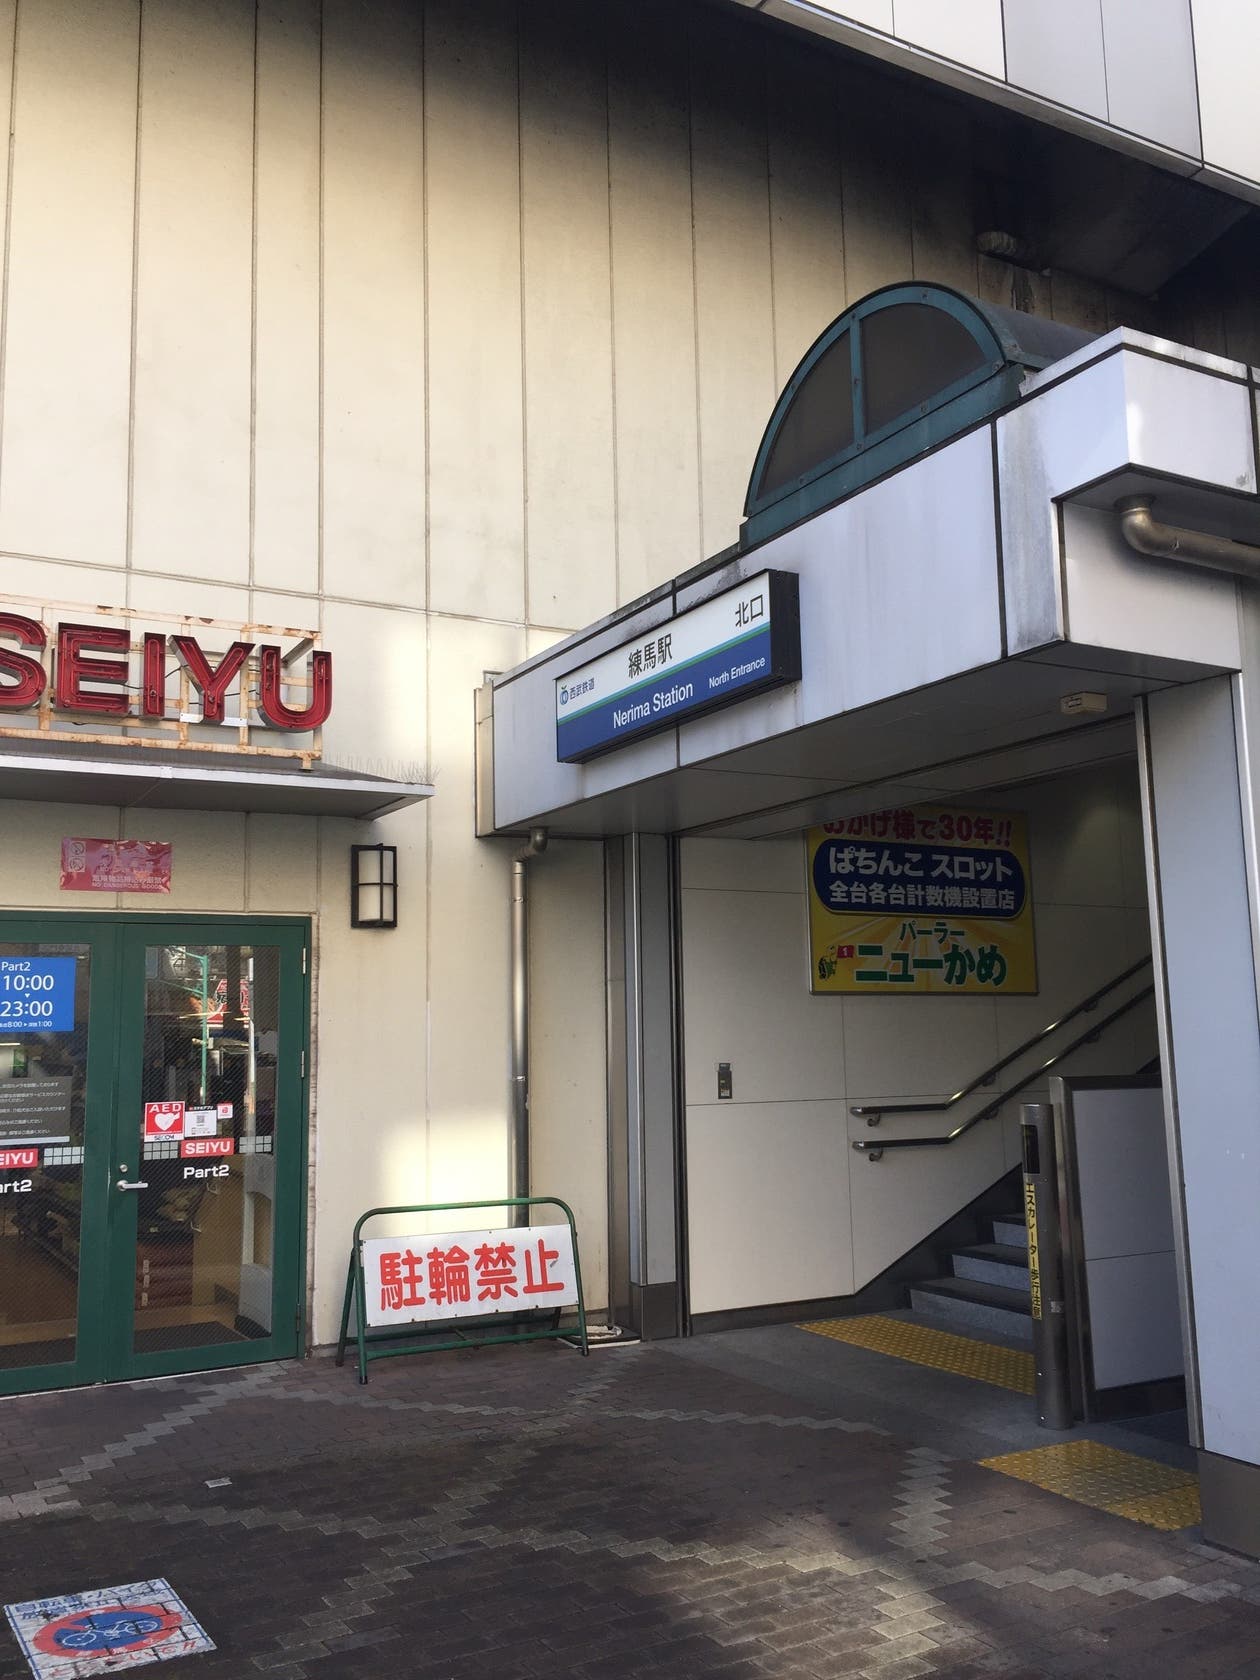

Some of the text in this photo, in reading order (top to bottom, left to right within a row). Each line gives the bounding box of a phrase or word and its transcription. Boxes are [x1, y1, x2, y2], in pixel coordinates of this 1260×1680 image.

[735, 594, 763, 627] 北口
[628, 633, 672, 679] 練馬駅
[0, 612, 332, 733] SEIYU
[709, 657, 766, 688] North Entrance
[569, 677, 594, 700] 西武鉄道
[613, 683, 694, 729] Nerima Station
[829, 846, 1013, 882] ぱちんこ スロット
[829, 880, 1015, 910] 全台各台計数機設置店
[900, 919, 965, 944] パーラー
[1, 961, 31, 971] Part2
[855, 943, 1007, 987] ニューかめ
[3, 974, 54, 991] 10:00
[0, 1000, 53, 1017] 23:00
[149, 1103, 182, 1113] AED
[185, 1141, 231, 1155] SEIYU
[183, 1164, 230, 1179] Part2
[380, 1238, 565, 1312] 駐輪禁止
